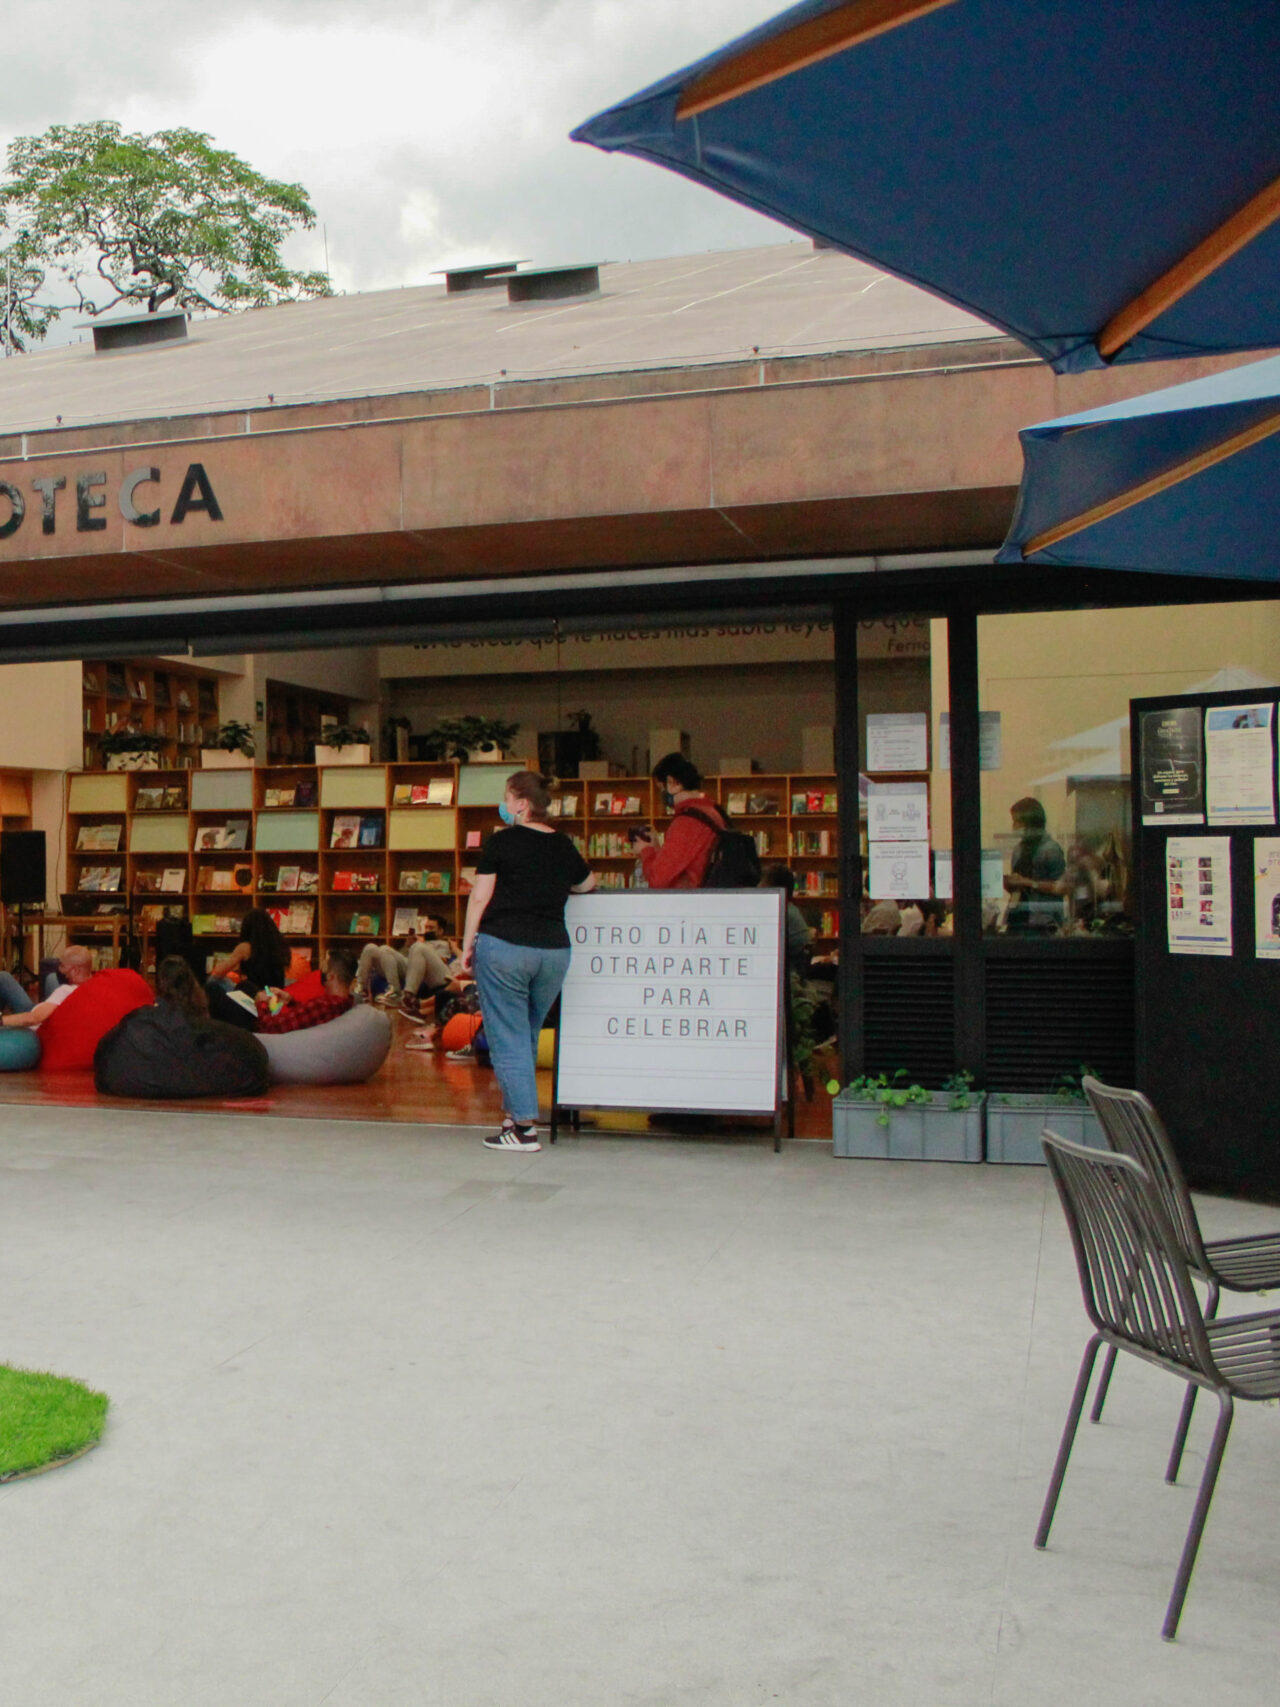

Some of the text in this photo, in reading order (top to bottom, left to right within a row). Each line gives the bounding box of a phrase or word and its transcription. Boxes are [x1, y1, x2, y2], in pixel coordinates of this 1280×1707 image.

[575, 921, 756, 945] OTRO DÍA EN
[590, 956, 748, 976] OTRAPARTE
[643, 988, 711, 1006] PARA
[607, 1017, 748, 1037] CELEBRAR
